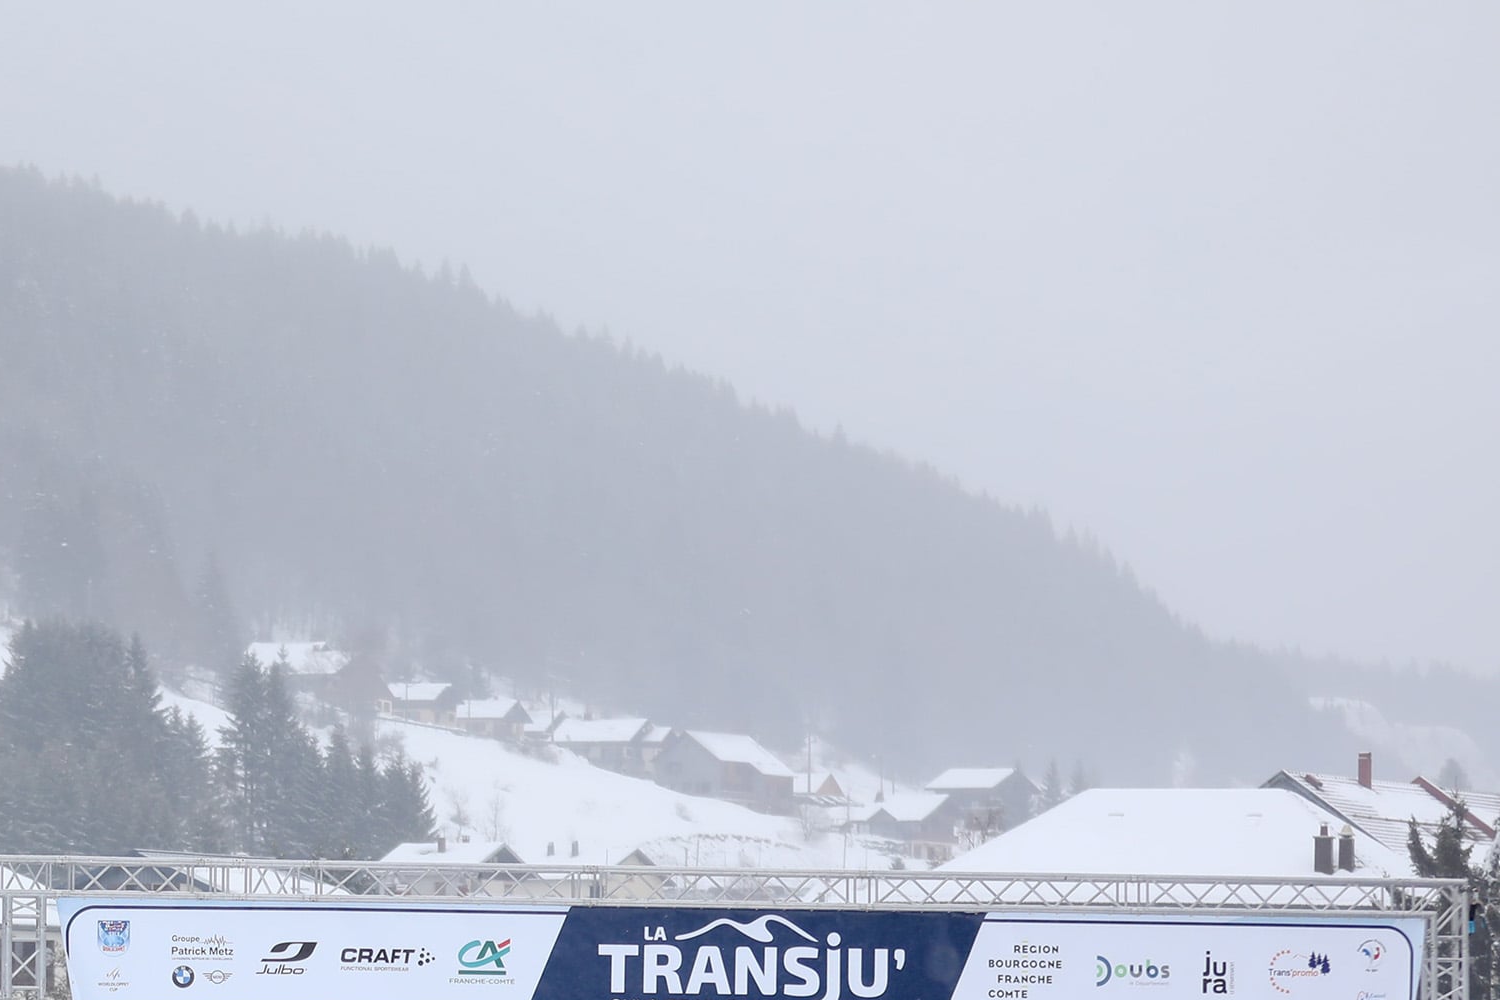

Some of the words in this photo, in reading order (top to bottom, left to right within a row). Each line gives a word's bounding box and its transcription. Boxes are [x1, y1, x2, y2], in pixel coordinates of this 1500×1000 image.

[643, 926, 667, 941] LA
[171, 934, 201, 944] Groupe
[171, 946, 207, 956] Patrick
[208, 947, 234, 956] Metz
[1013, 945, 1060, 954] REGION
[340, 948, 416, 964] CRAFT
[988, 959, 1063, 969] BOURGOGNE
[1203, 950, 1227, 977] ju
[255, 964, 306, 975] Julbo
[1096, 955, 1170, 987] Doubs
[1268, 968, 1319, 978] Trans'promo
[997, 974, 1053, 984] FRANCHE
[1202, 978, 1228, 994] ra
[988, 990, 1028, 999] COMTE
